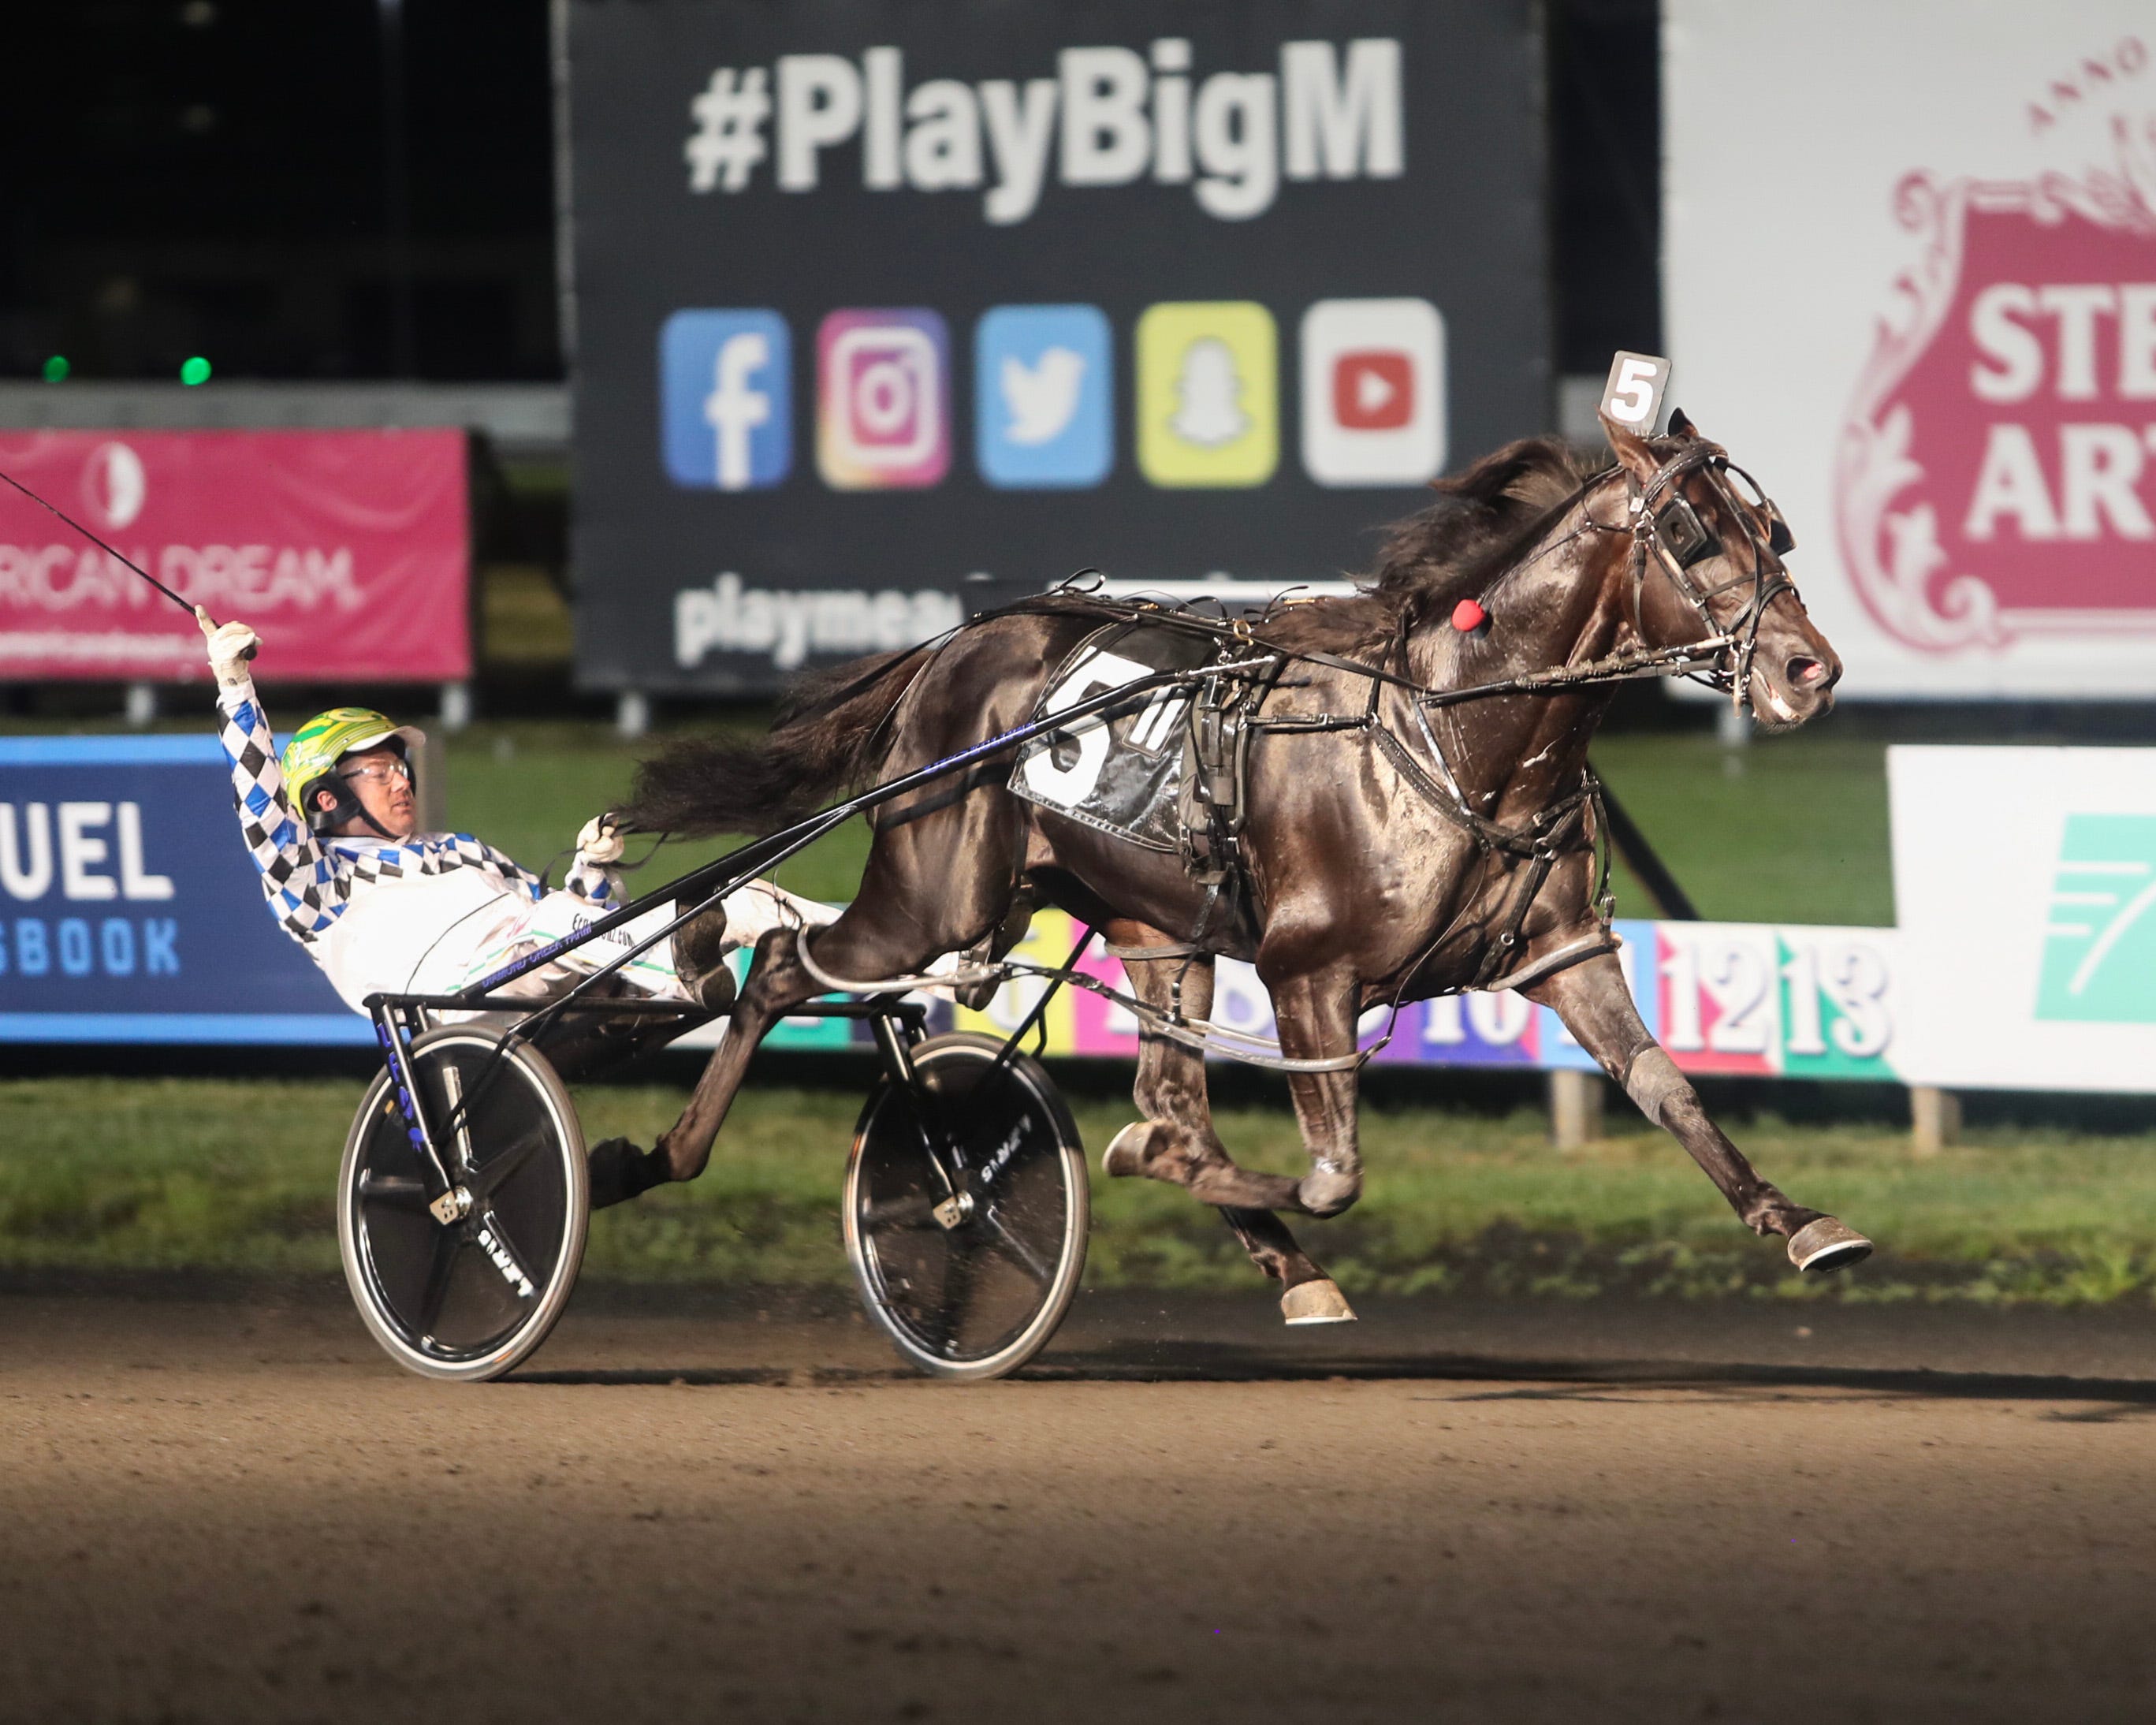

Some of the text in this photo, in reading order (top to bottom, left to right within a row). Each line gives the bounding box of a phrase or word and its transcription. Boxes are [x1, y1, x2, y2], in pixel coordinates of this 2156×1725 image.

[686, 38, 1405, 225] #PlayBigM
[2024, 35, 2148, 136] ANNO
[1610, 358, 1657, 422] 5
[1964, 421, 2156, 540] AR
[0, 801, 174, 900] UEL
[0, 918, 180, 976] BOOK
[1661, 944, 1768, 1053] 12
[1781, 944, 1890, 1057] 13
